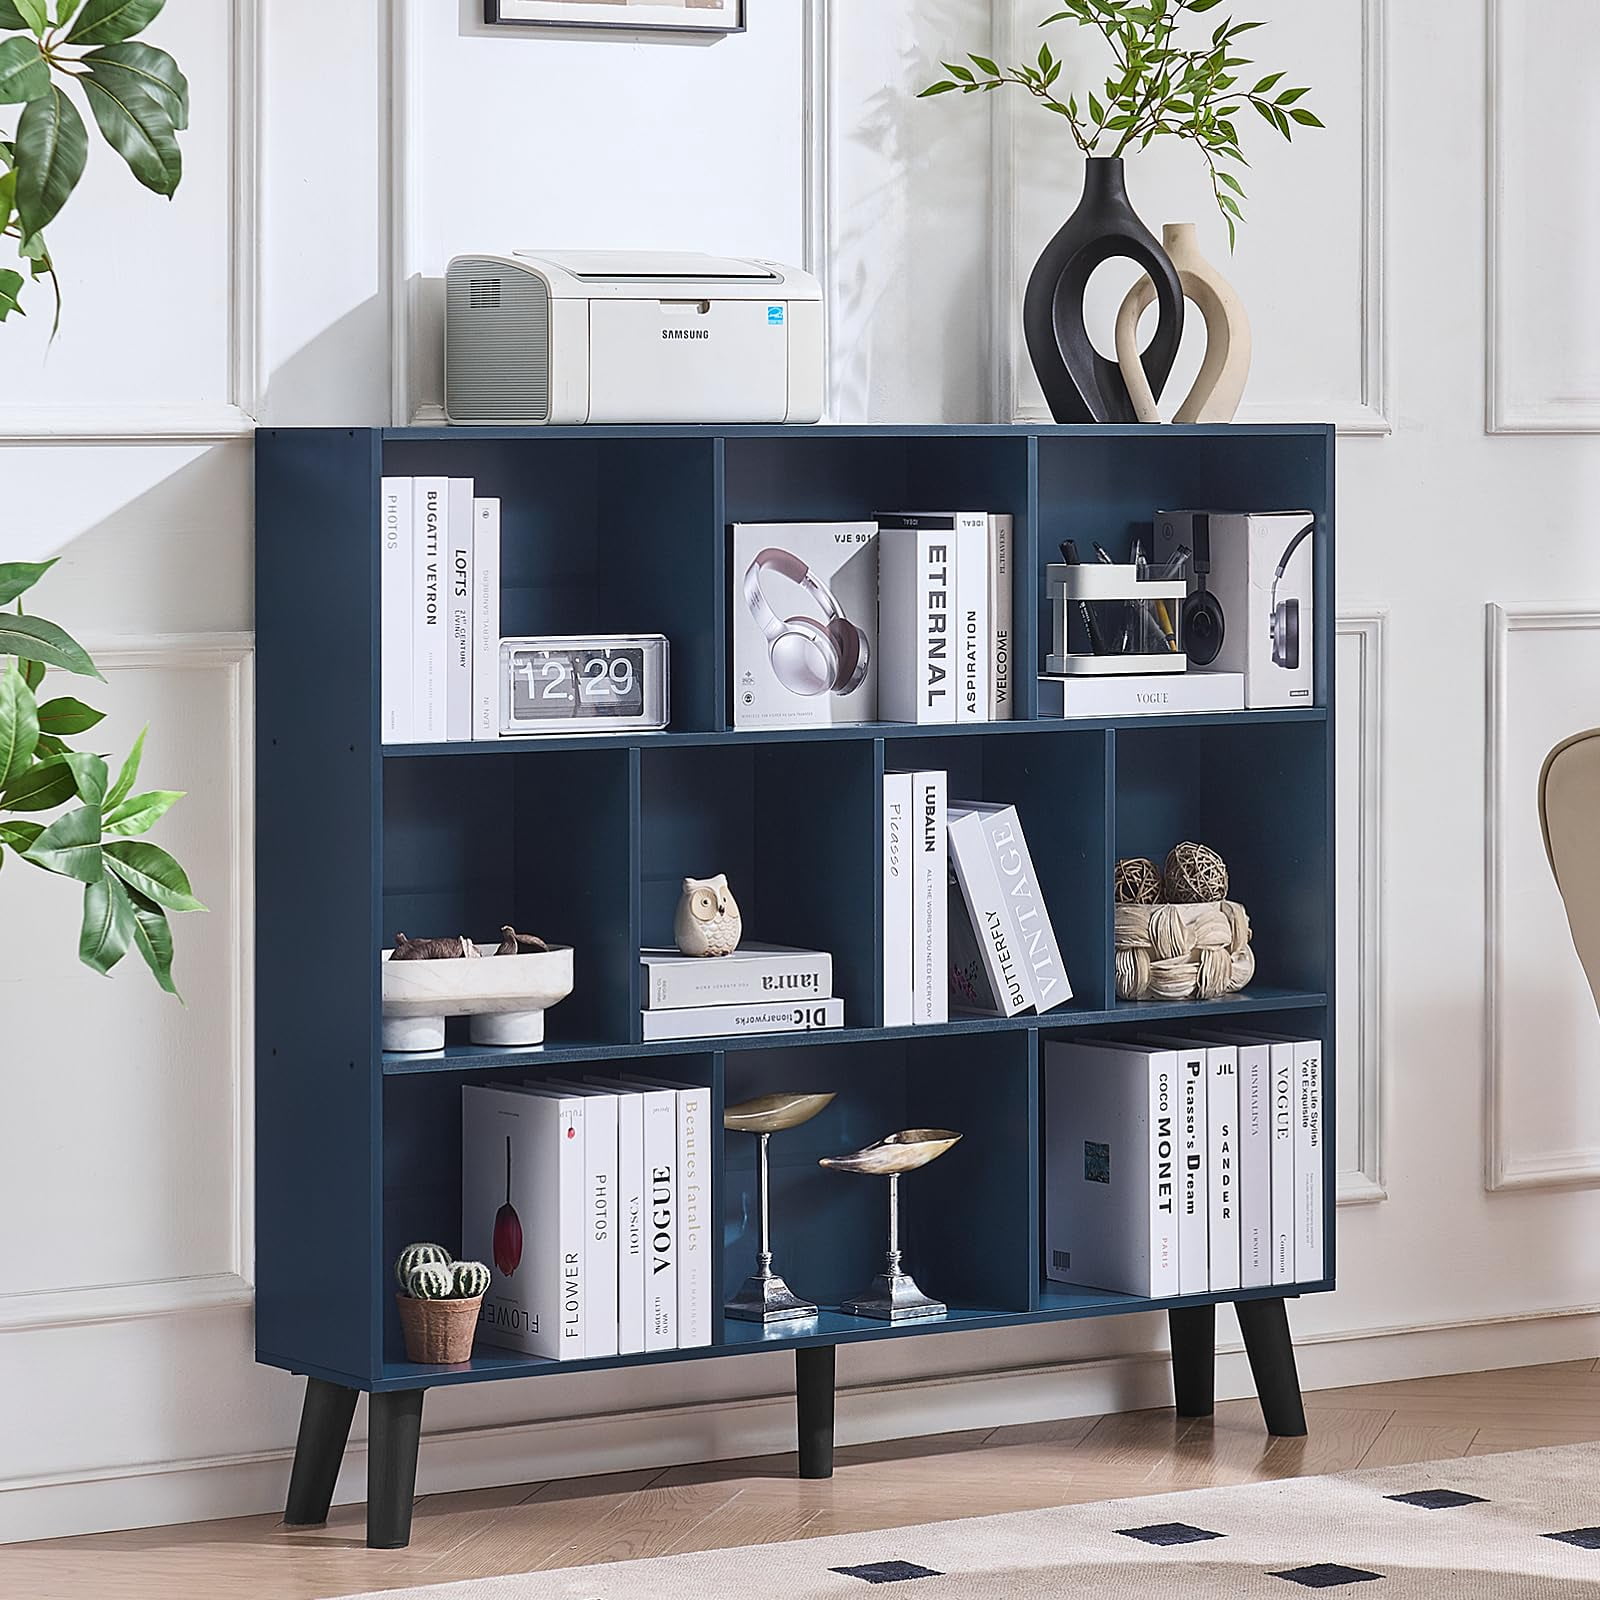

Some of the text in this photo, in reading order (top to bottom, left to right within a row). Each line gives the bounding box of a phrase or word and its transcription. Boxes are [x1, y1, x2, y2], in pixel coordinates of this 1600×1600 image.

[661, 329, 709, 340] SAMSUNG
[387, 495, 398, 550] PHOTOS
[833, 533, 872, 544] VJE 901
[902, 518, 919, 526] IDEAL
[961, 519, 984, 527] IDEAL
[426, 490, 438, 626] BUGATTI VEYRON
[454, 549, 467, 597] LOFTS
[927, 544, 948, 708] ETERNAL
[966, 610, 977, 714] ASPIRATION
[996, 630, 1008, 704] WELCOME
[1136, 692, 1169, 704] VOGUE
[889, 802, 902, 878] Picasso
[925, 785, 936, 853] LUBALIN
[992, 821, 1058, 1001] VINTAGE
[984, 910, 1025, 1007] BUTTERFLY
[1216, 1063, 1235, 1076] JIL
[1276, 1066, 1290, 1140] VOGUE
[1157, 1073, 1172, 1214] COCO MONET
[1186, 1060, 1201, 1215] Picasso's Dream
[1310, 1111, 1318, 1147] Stylish
[685, 1101, 701, 1252] Beautes fatales
[1221, 1124, 1231, 1220] SANDER
[594, 1174, 608, 1242] PHOTOS
[629, 1195, 640, 1255] HOPSCA
[652, 1166, 672, 1276] VOGUE
[1161, 1236, 1169, 1269] PARIS
[1279, 1233, 1287, 1274] Common
[564, 1252, 579, 1339] FLOWER
